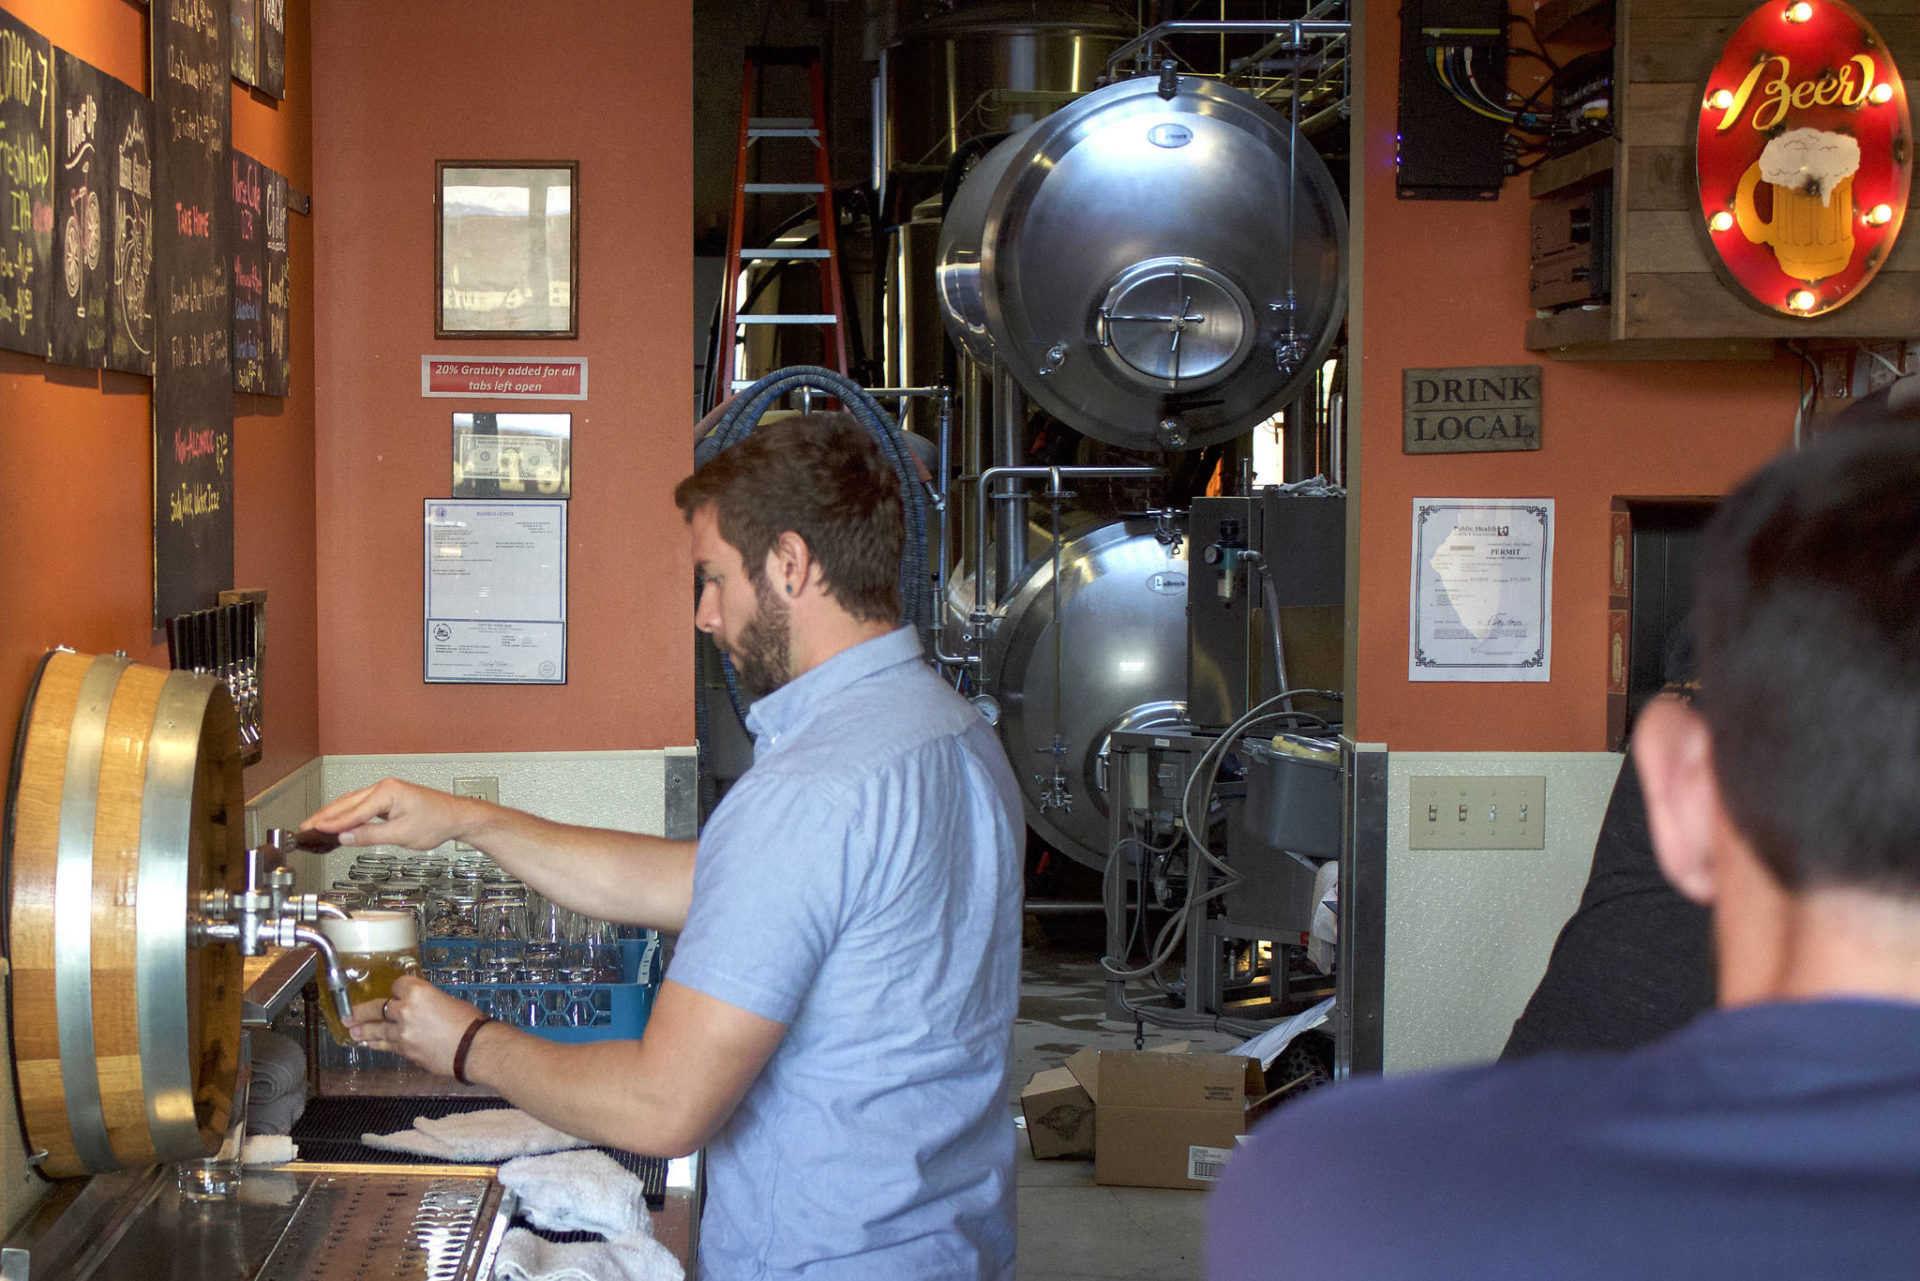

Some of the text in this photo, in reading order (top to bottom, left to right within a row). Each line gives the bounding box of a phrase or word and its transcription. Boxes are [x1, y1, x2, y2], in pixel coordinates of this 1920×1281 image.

[1716, 54, 1874, 130] Beer
[435, 364, 576, 378] 20% Gratuity added for all
[468, 380, 541, 392] tabs left open
[1413, 376, 1533, 404] DRINK
[1413, 414, 1535, 442] LOCAL
[1490, 548, 1521, 556] PERMIT
